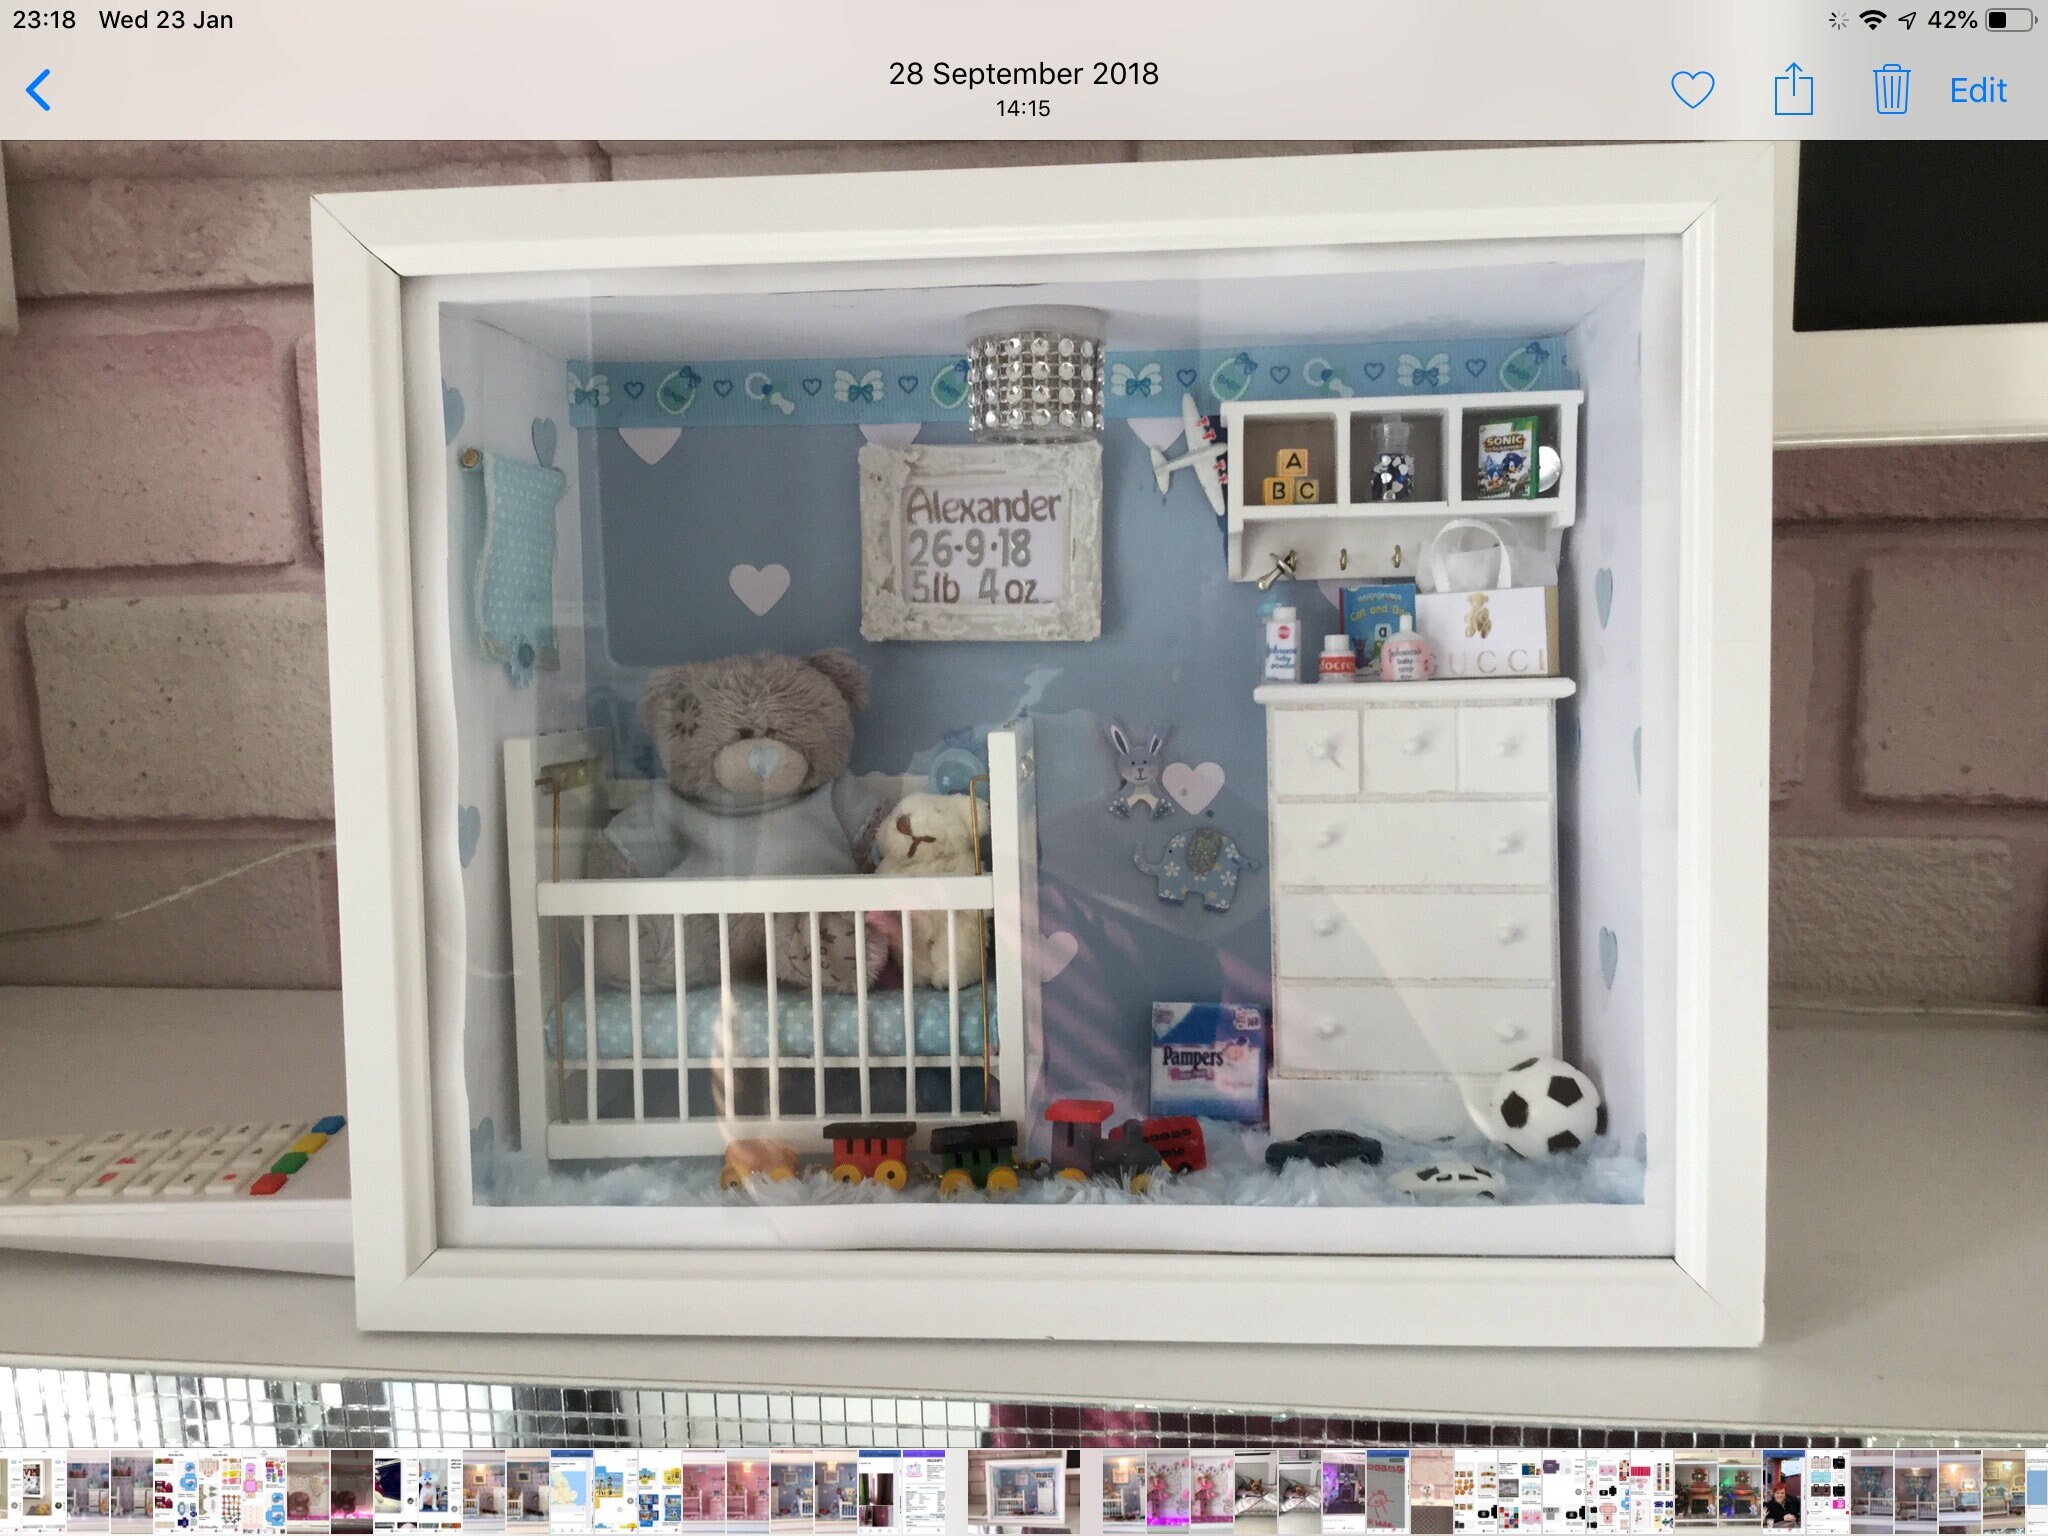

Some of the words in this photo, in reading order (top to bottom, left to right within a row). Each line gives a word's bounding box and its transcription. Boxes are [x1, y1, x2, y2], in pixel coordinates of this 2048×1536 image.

[1486, 433, 1524, 448] SONIC
[1285, 452, 1302, 469] A
[1272, 481, 1286, 500] B
[1299, 482, 1315, 499] C
[906, 487, 1062, 525] Alexander
[910, 569, 961, 604] 5lb
[978, 567, 999, 604] 4
[1004, 578, 1040, 604] oz
[1378, 625, 1388, 638] a
[1162, 1046, 1224, 1070] Pampers
